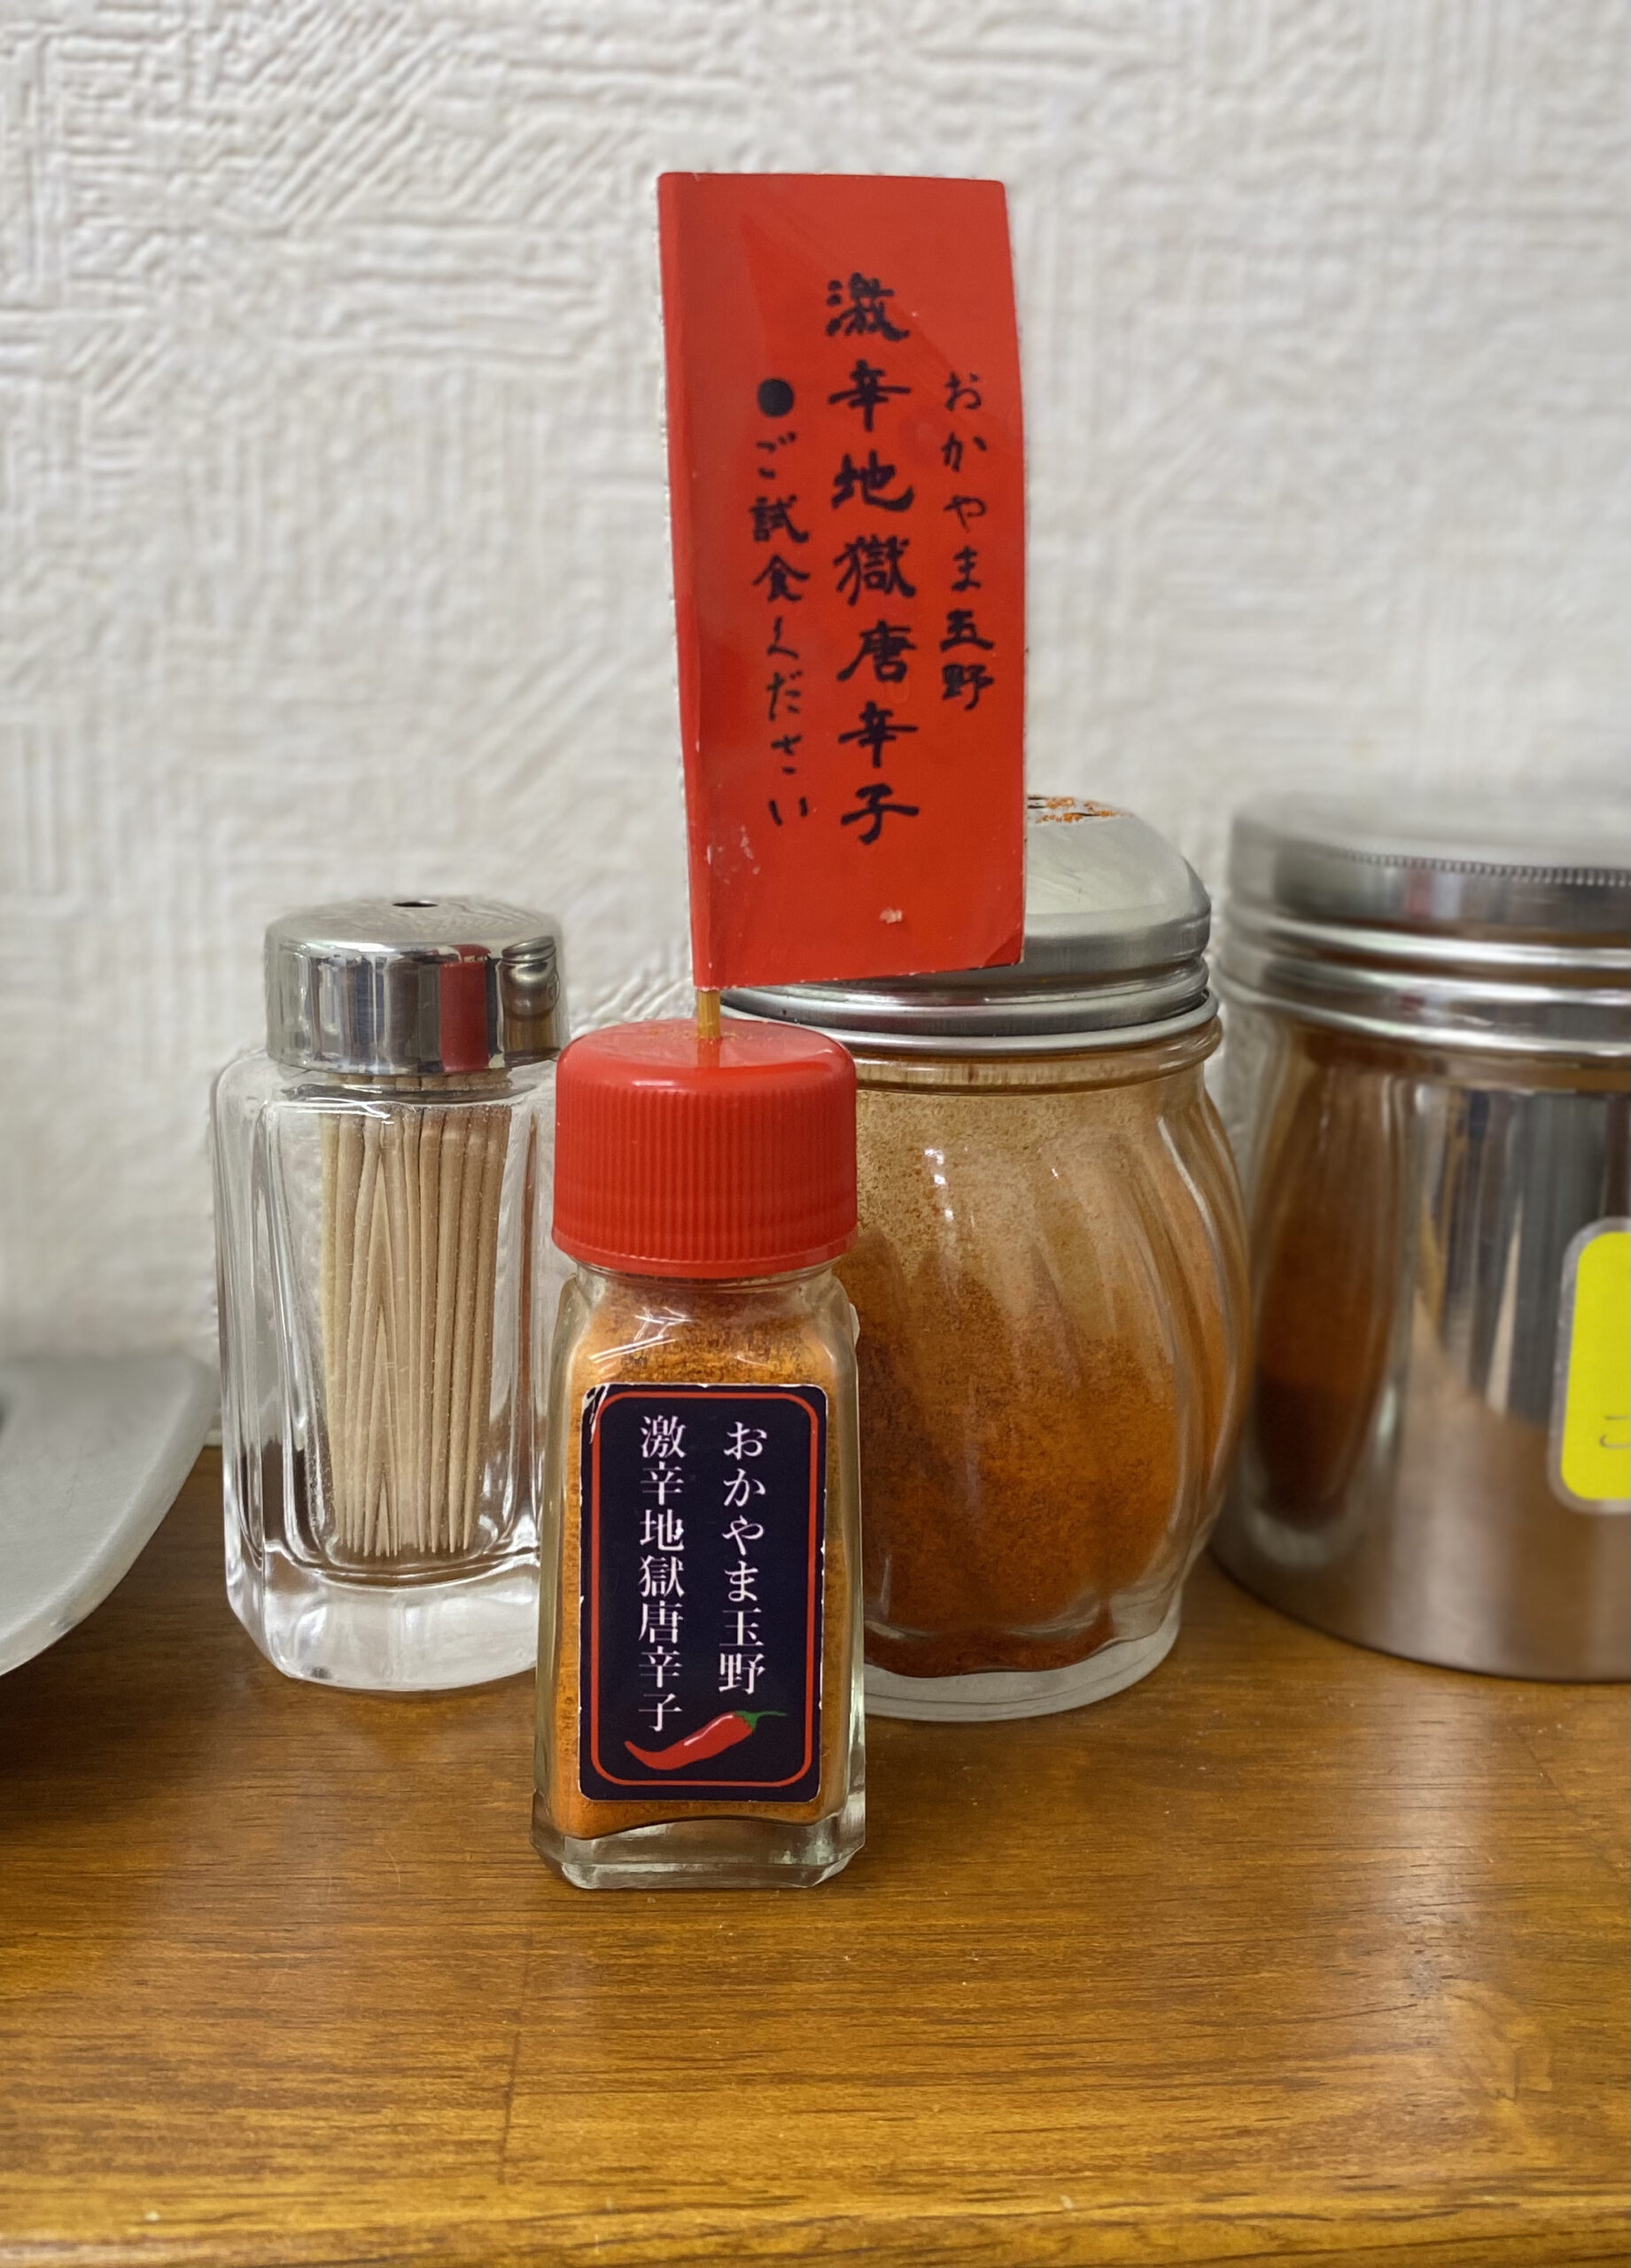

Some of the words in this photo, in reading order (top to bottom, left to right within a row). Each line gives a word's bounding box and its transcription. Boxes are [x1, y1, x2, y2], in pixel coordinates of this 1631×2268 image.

[749, 431, 810, 826] ご試食ください
[825, 272, 920, 845] 激辛地獄唐辛子
[638, 1415, 687, 1733] 激辛地獄唐辛子
[718, 1420, 768, 1695] おかやま玉野
